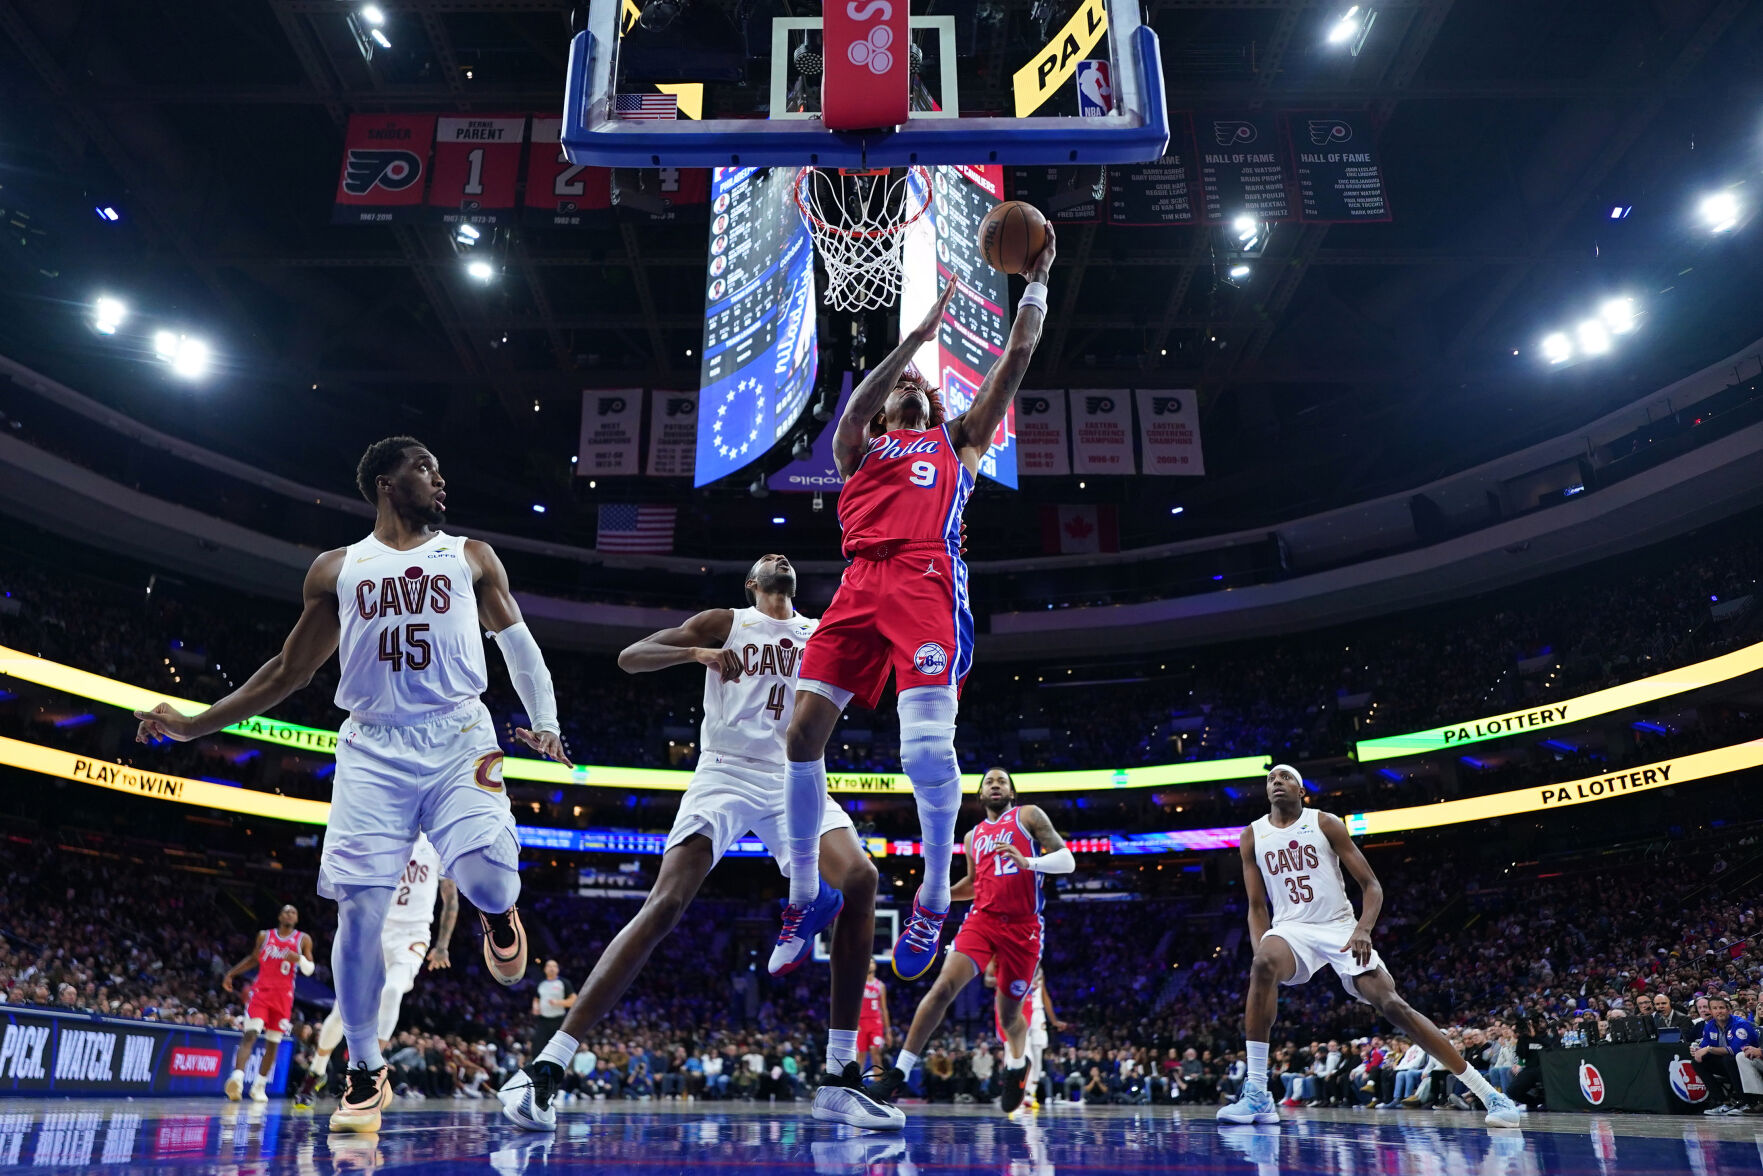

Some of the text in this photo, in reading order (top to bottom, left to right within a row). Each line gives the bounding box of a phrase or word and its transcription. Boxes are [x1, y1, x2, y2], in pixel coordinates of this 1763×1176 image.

[1038, 33, 1080, 91] PA
[1085, 106, 1102, 117] NBA
[456, 128, 504, 140] PARENT
[464, 148, 484, 194] 1
[1206, 154, 1276, 163] HALL OF FAME
[1301, 154, 1371, 162] HALL OF FAME
[964, 166, 996, 194] CAVALIERS
[868, 435, 940, 460] Phila
[909, 460, 938, 490] 9
[356, 574, 452, 620] CAVS
[378, 624, 431, 672] 45
[766, 684, 785, 720] 4
[238, 719, 338, 749] PA LOTTER
[1444, 706, 1568, 744] PA LOTTERY
[73, 760, 120, 784] PLAY
[140, 774, 184, 800] WIN!
[860, 777, 895, 790] WIN!
[1541, 765, 1672, 804] PA LOTTERY
[994, 854, 1019, 876] 12
[1264, 844, 1318, 875] CAVS
[397, 886, 410, 906] 2
[1284, 876, 1314, 904] 35
[173, 1054, 197, 1071] PLAY
[197, 1056, 218, 1072] NOW
